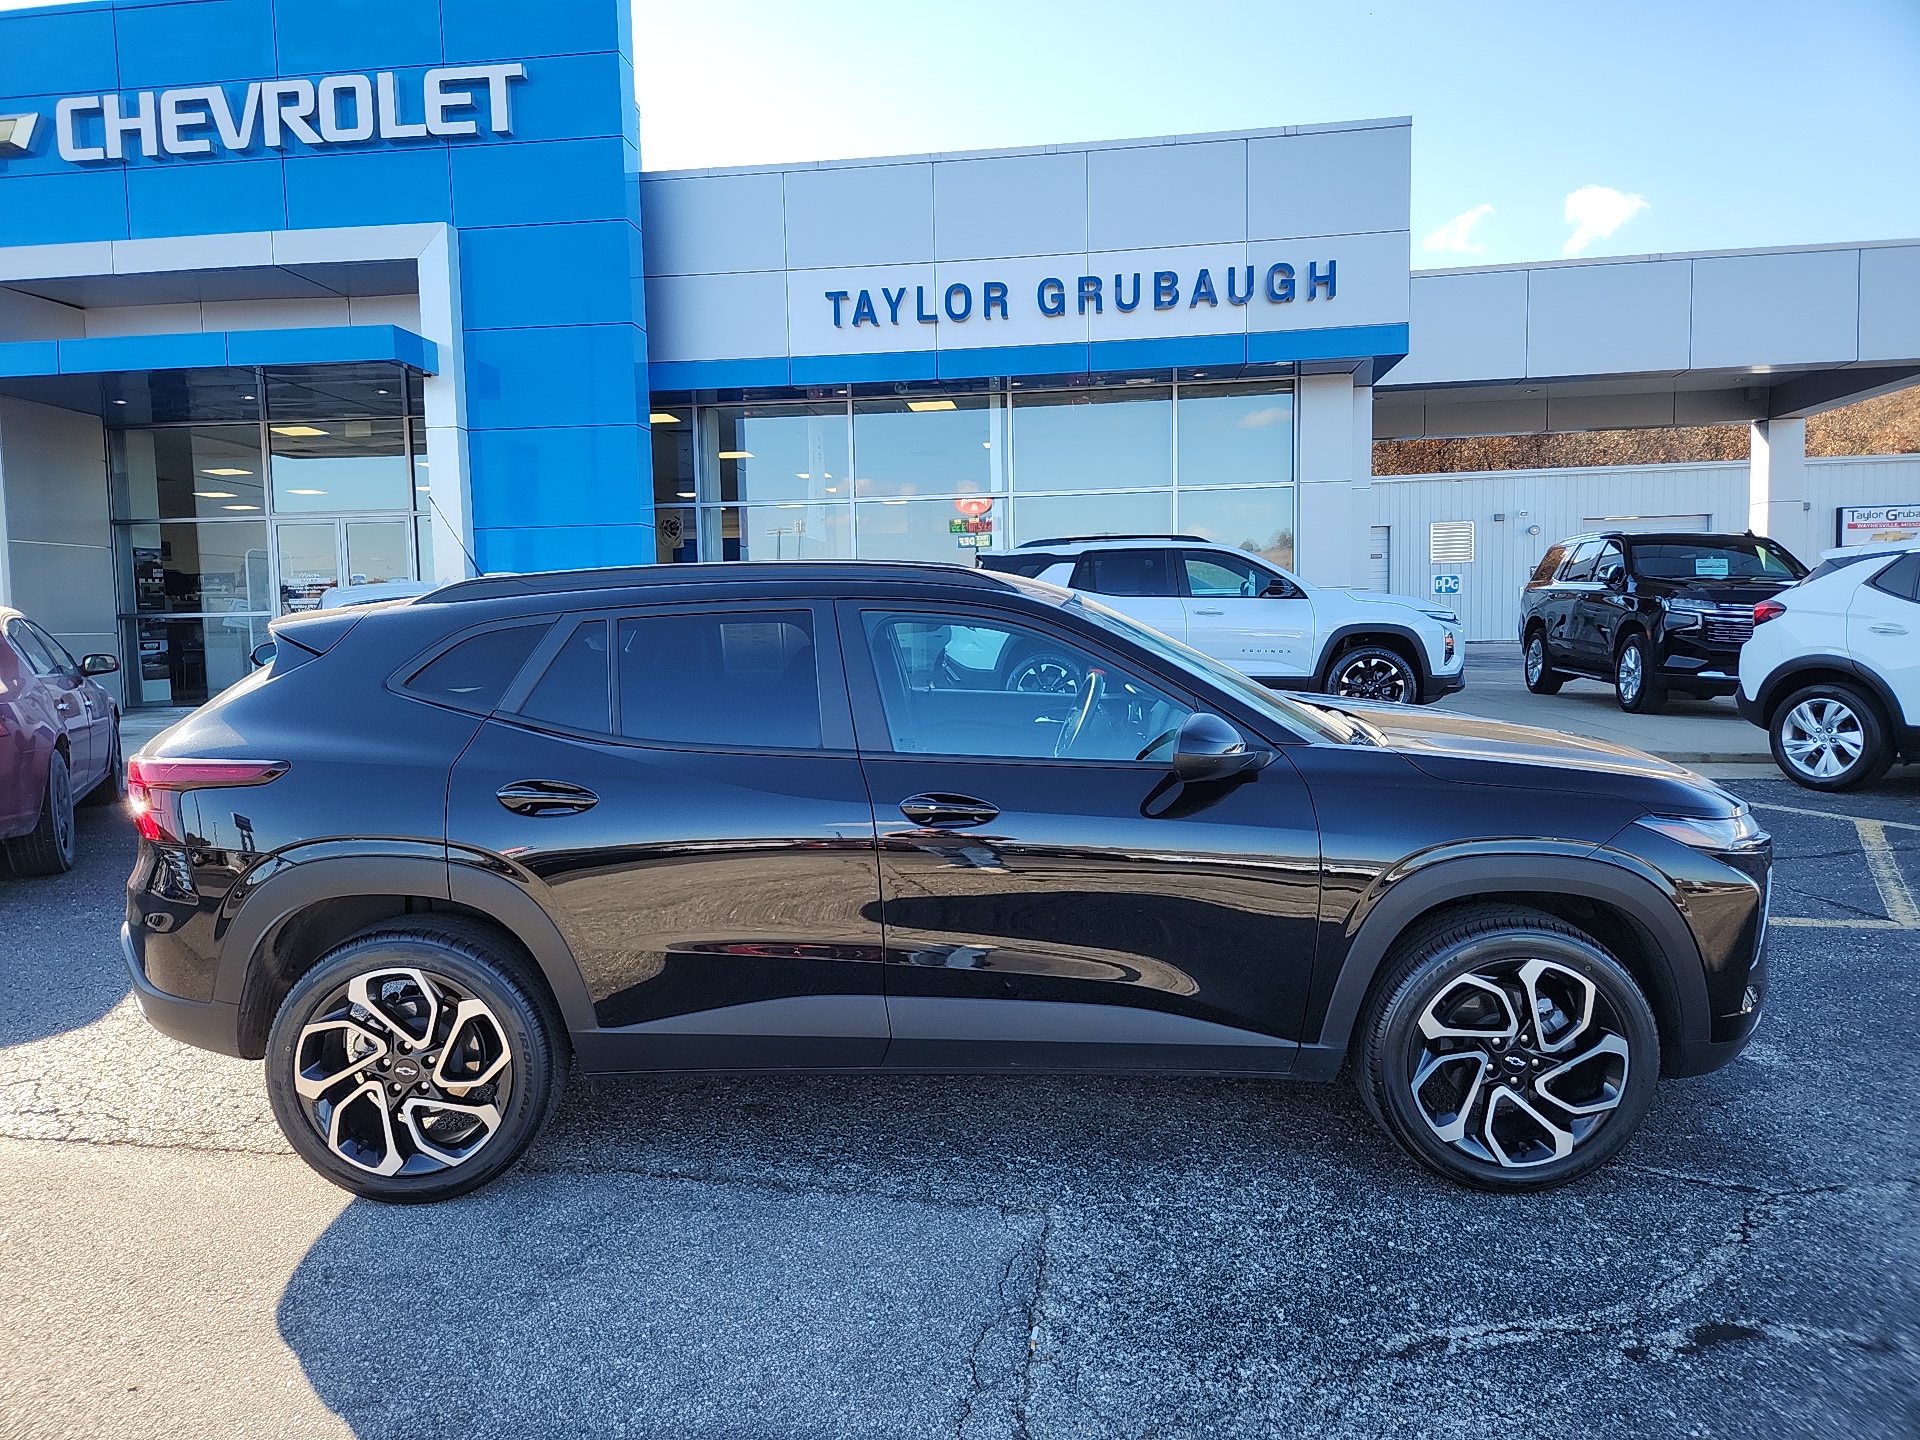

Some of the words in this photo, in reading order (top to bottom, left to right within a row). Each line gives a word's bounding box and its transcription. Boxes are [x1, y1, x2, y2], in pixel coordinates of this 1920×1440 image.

[55, 63, 526, 164] CHEVROLET
[825, 281, 1009, 328] TAYLOR
[1037, 259, 1337, 317] GRUBAUGH
[1847, 509, 1883, 522] Taylor
[1436, 577, 1458, 592] PPG
[518, 1031, 533, 1119] IRONMAN
